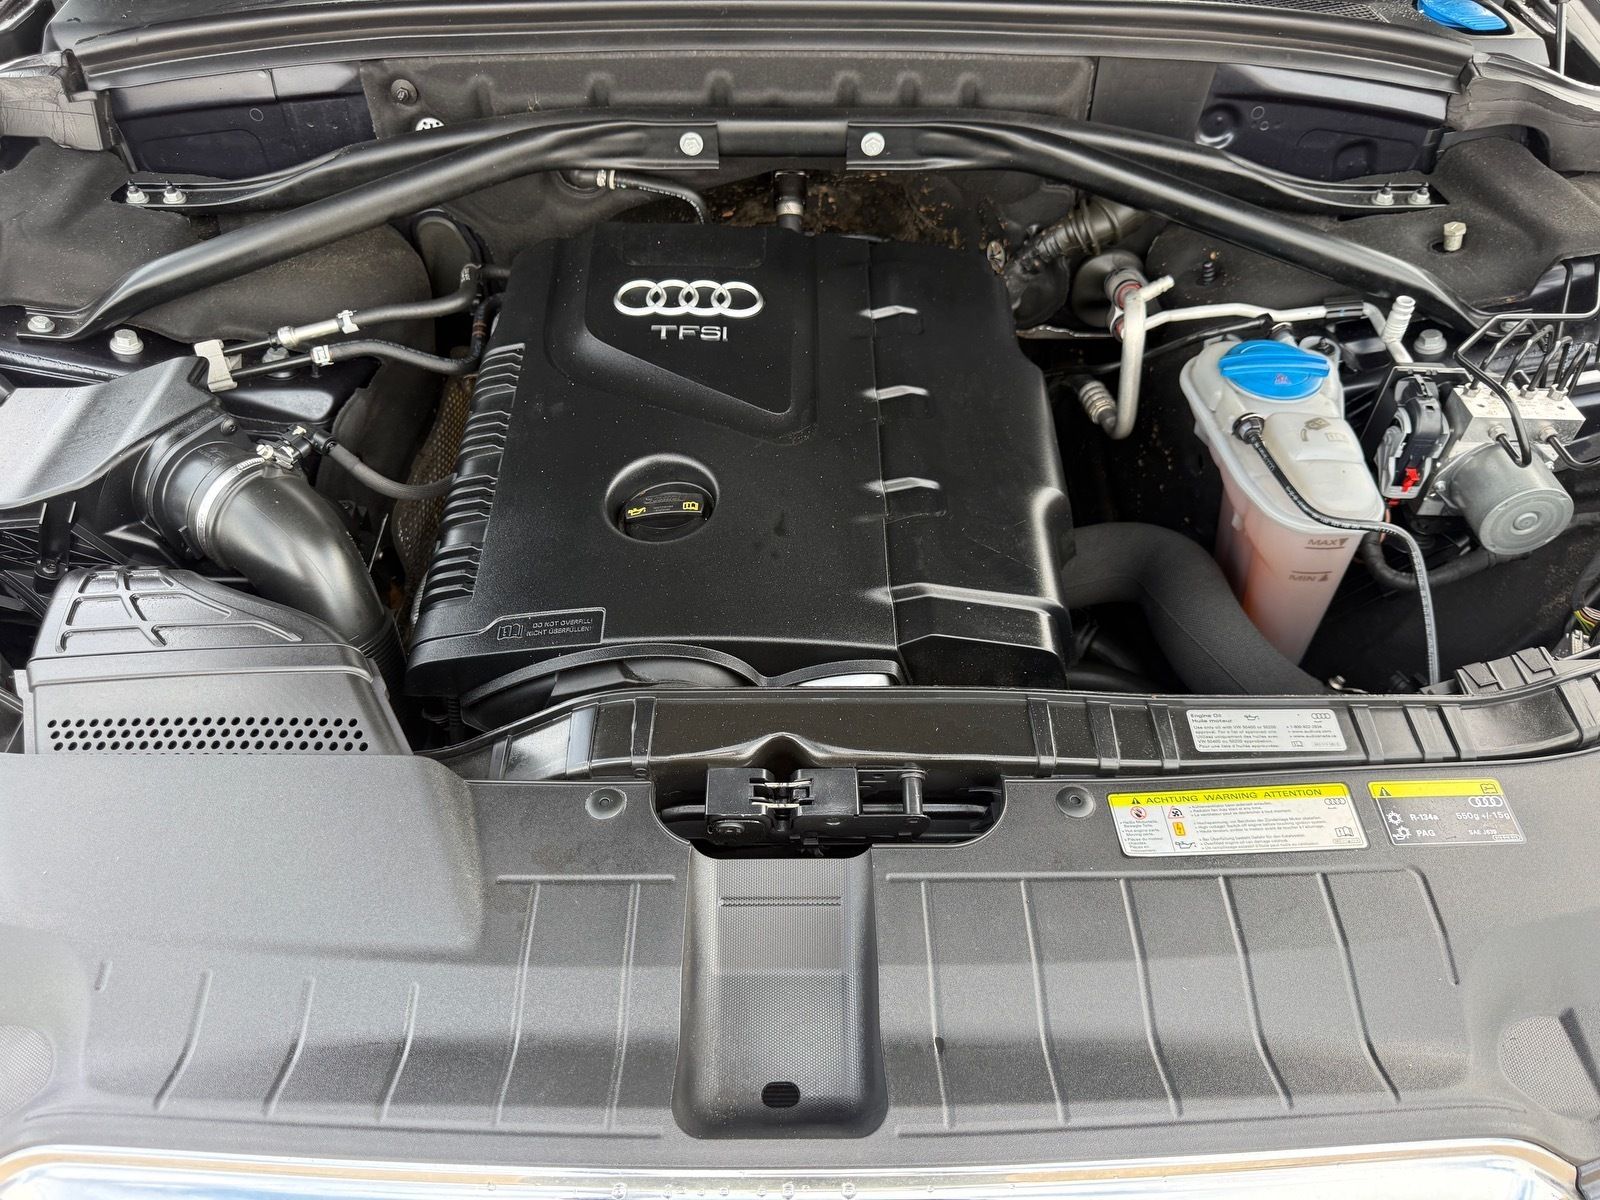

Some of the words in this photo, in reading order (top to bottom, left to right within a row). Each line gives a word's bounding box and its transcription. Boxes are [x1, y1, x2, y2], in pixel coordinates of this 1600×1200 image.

[651, 324, 728, 342] TFSI
[1146, 795, 1198, 804] ACHTUNG
[1204, 792, 1258, 801] WARNING
[1264, 789, 1322, 798] ATTENTION
[1456, 812, 1480, 820] 550g
